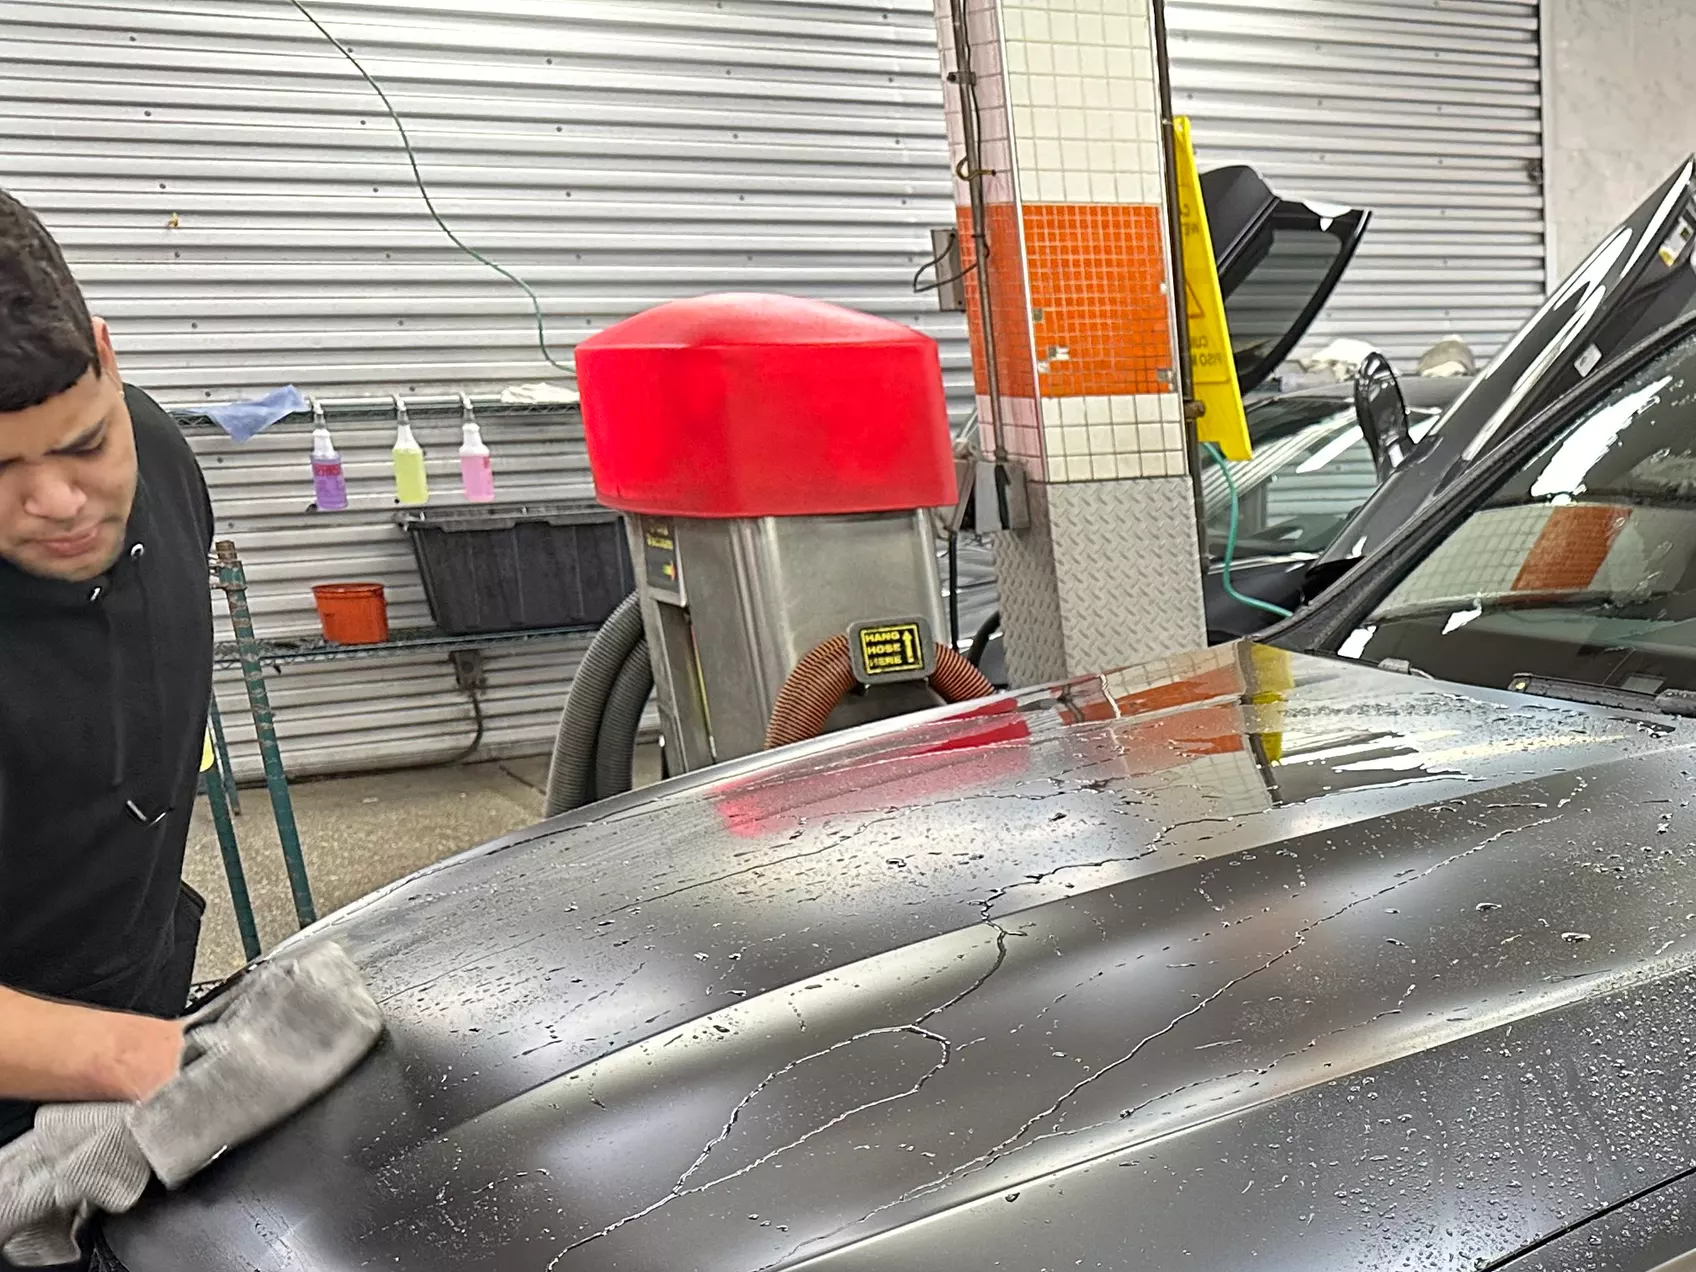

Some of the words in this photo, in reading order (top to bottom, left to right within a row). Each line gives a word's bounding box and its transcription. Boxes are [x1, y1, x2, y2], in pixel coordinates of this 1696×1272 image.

[865, 631, 900, 642] HANG
[867, 643, 901, 655] HOSE
[869, 655, 902, 666] HERE
